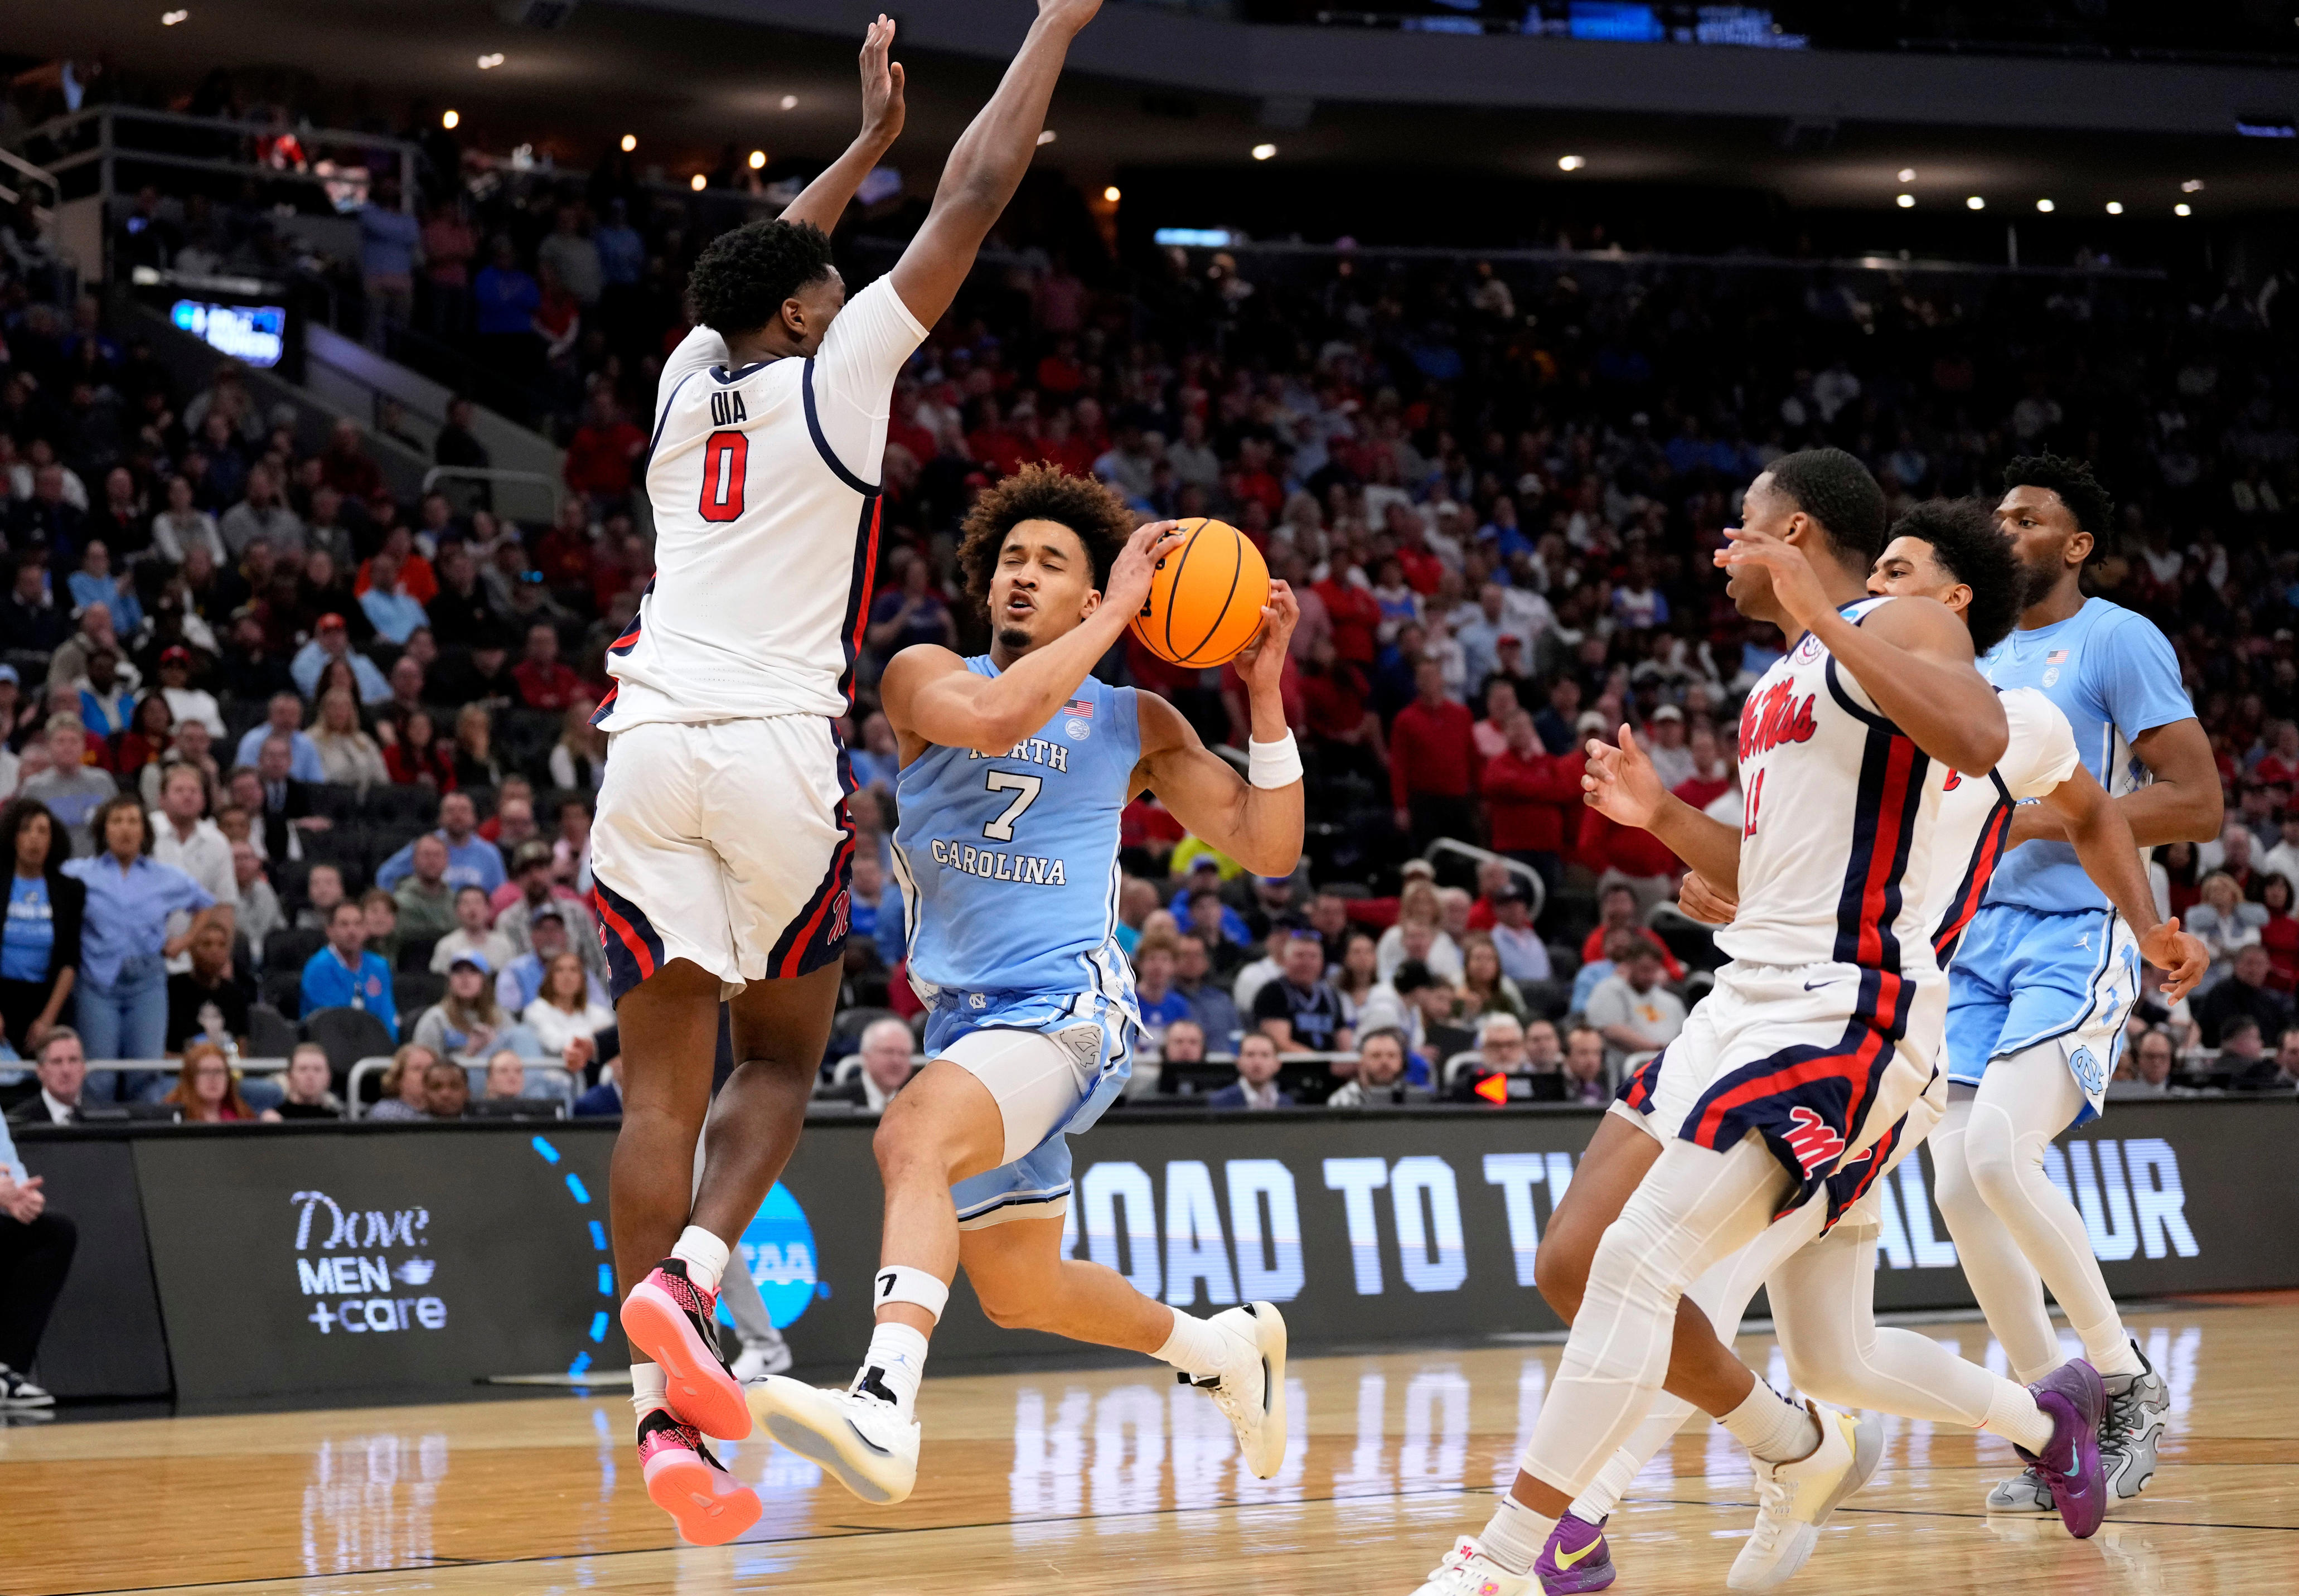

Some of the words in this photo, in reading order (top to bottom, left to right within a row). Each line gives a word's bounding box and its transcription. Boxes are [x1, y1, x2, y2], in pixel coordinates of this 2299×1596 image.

[710, 391, 747, 425] DIA
[699, 430, 749, 522] 0
[982, 769, 1043, 842] 7
[931, 839, 1066, 886] CAROLINA
[290, 1191, 429, 1250] Dove
[1060, 1158, 1305, 1306] OAD
[1323, 1156, 1468, 1295] TO
[297, 1256, 391, 1294] MEN
[878, 1274, 897, 1297] 7
